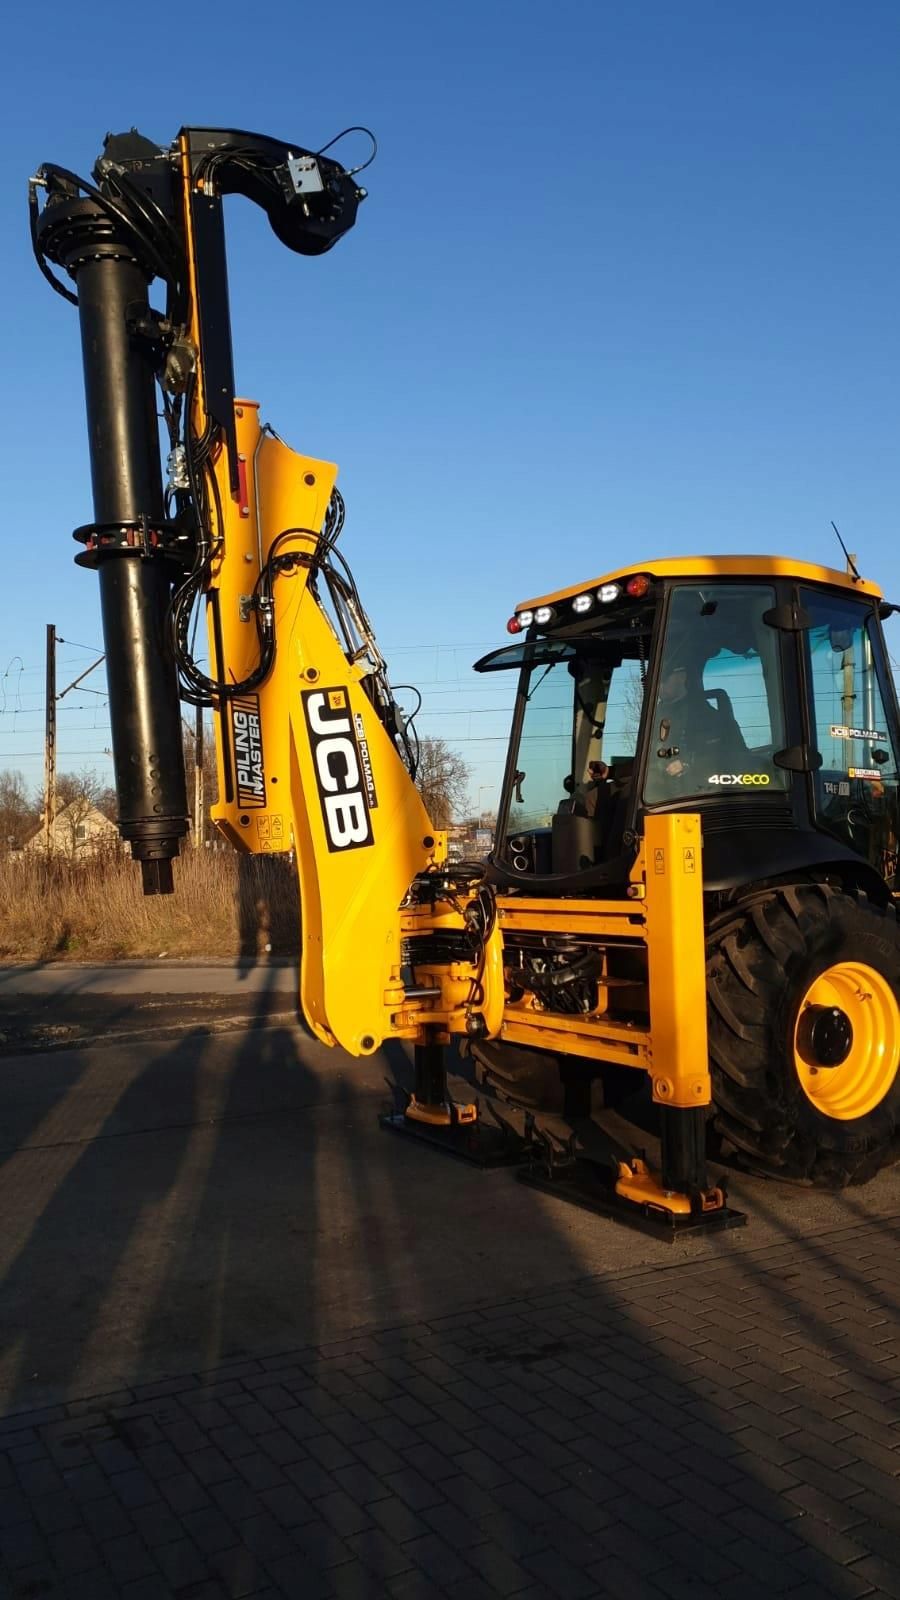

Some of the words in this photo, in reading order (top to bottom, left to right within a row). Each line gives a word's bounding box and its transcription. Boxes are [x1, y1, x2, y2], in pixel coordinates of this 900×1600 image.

[233, 711, 256, 788] PILING
[248, 714, 265, 795] MASTER
[353, 713, 366, 740] JCB
[307, 692, 369, 848] JCB
[359, 741, 375, 793] POLMAG
